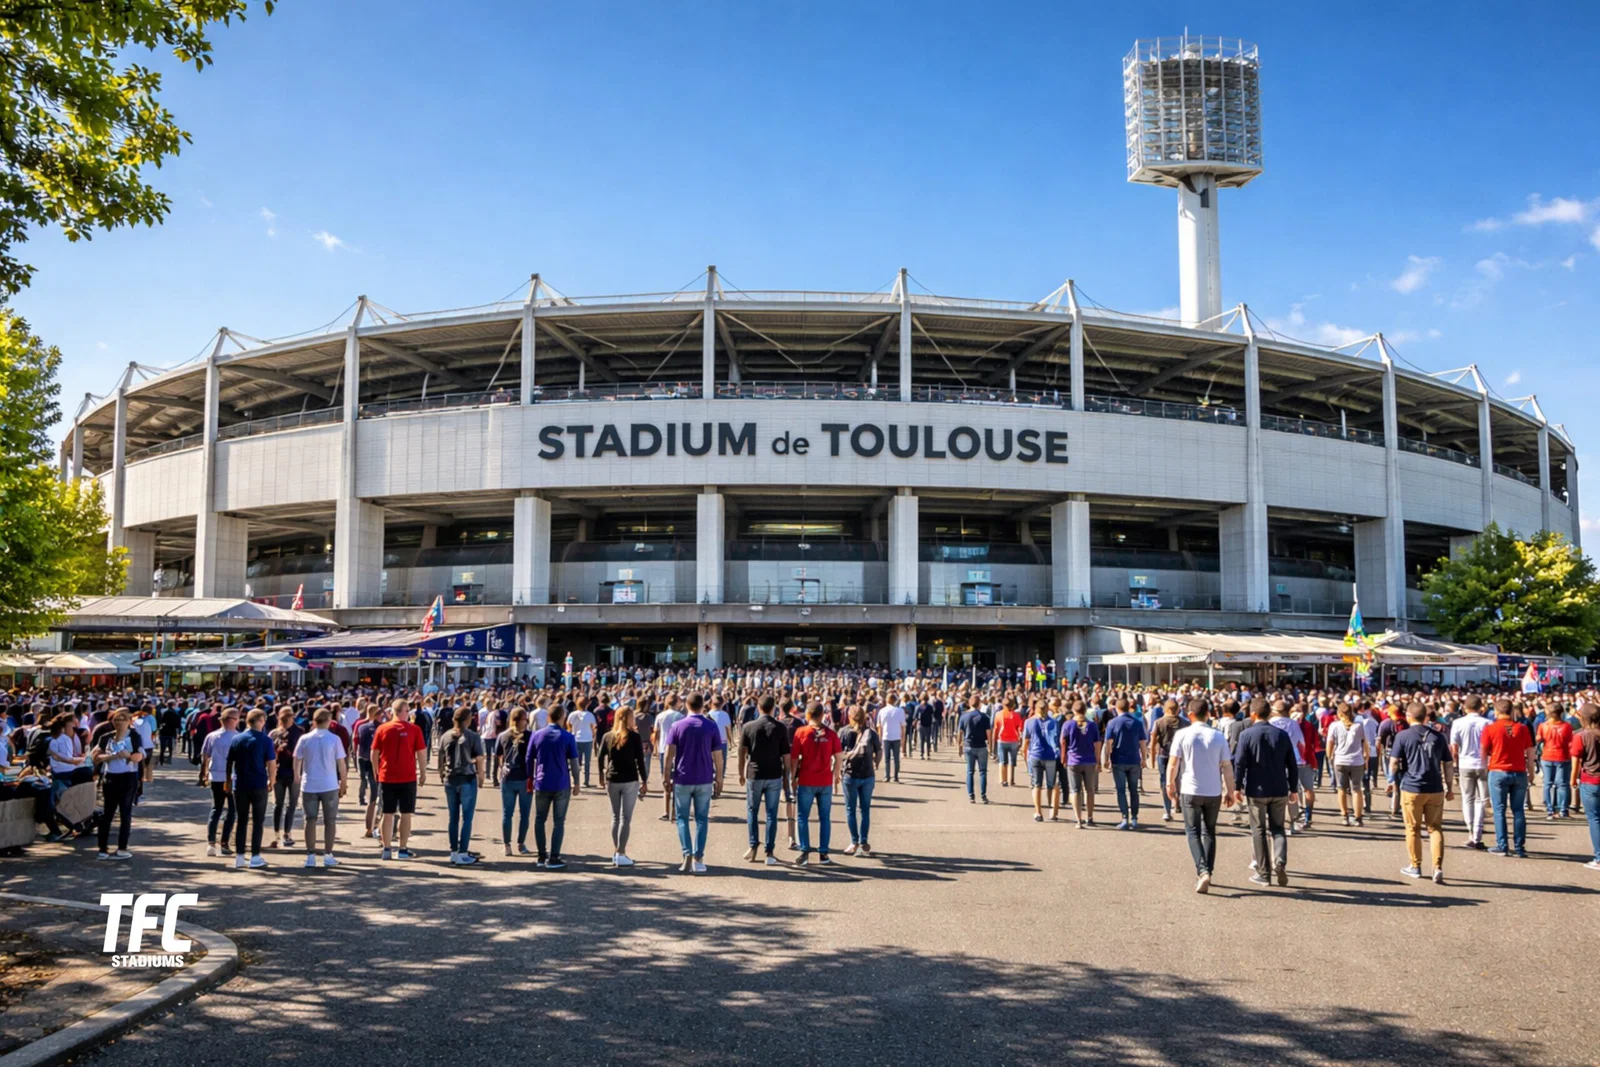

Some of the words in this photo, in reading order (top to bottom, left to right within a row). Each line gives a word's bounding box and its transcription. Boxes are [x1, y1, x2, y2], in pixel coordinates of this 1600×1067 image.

[538, 422, 757, 460] STADIUM
[771, 431, 809, 456] de
[821, 424, 1069, 464] TOULOUSE
